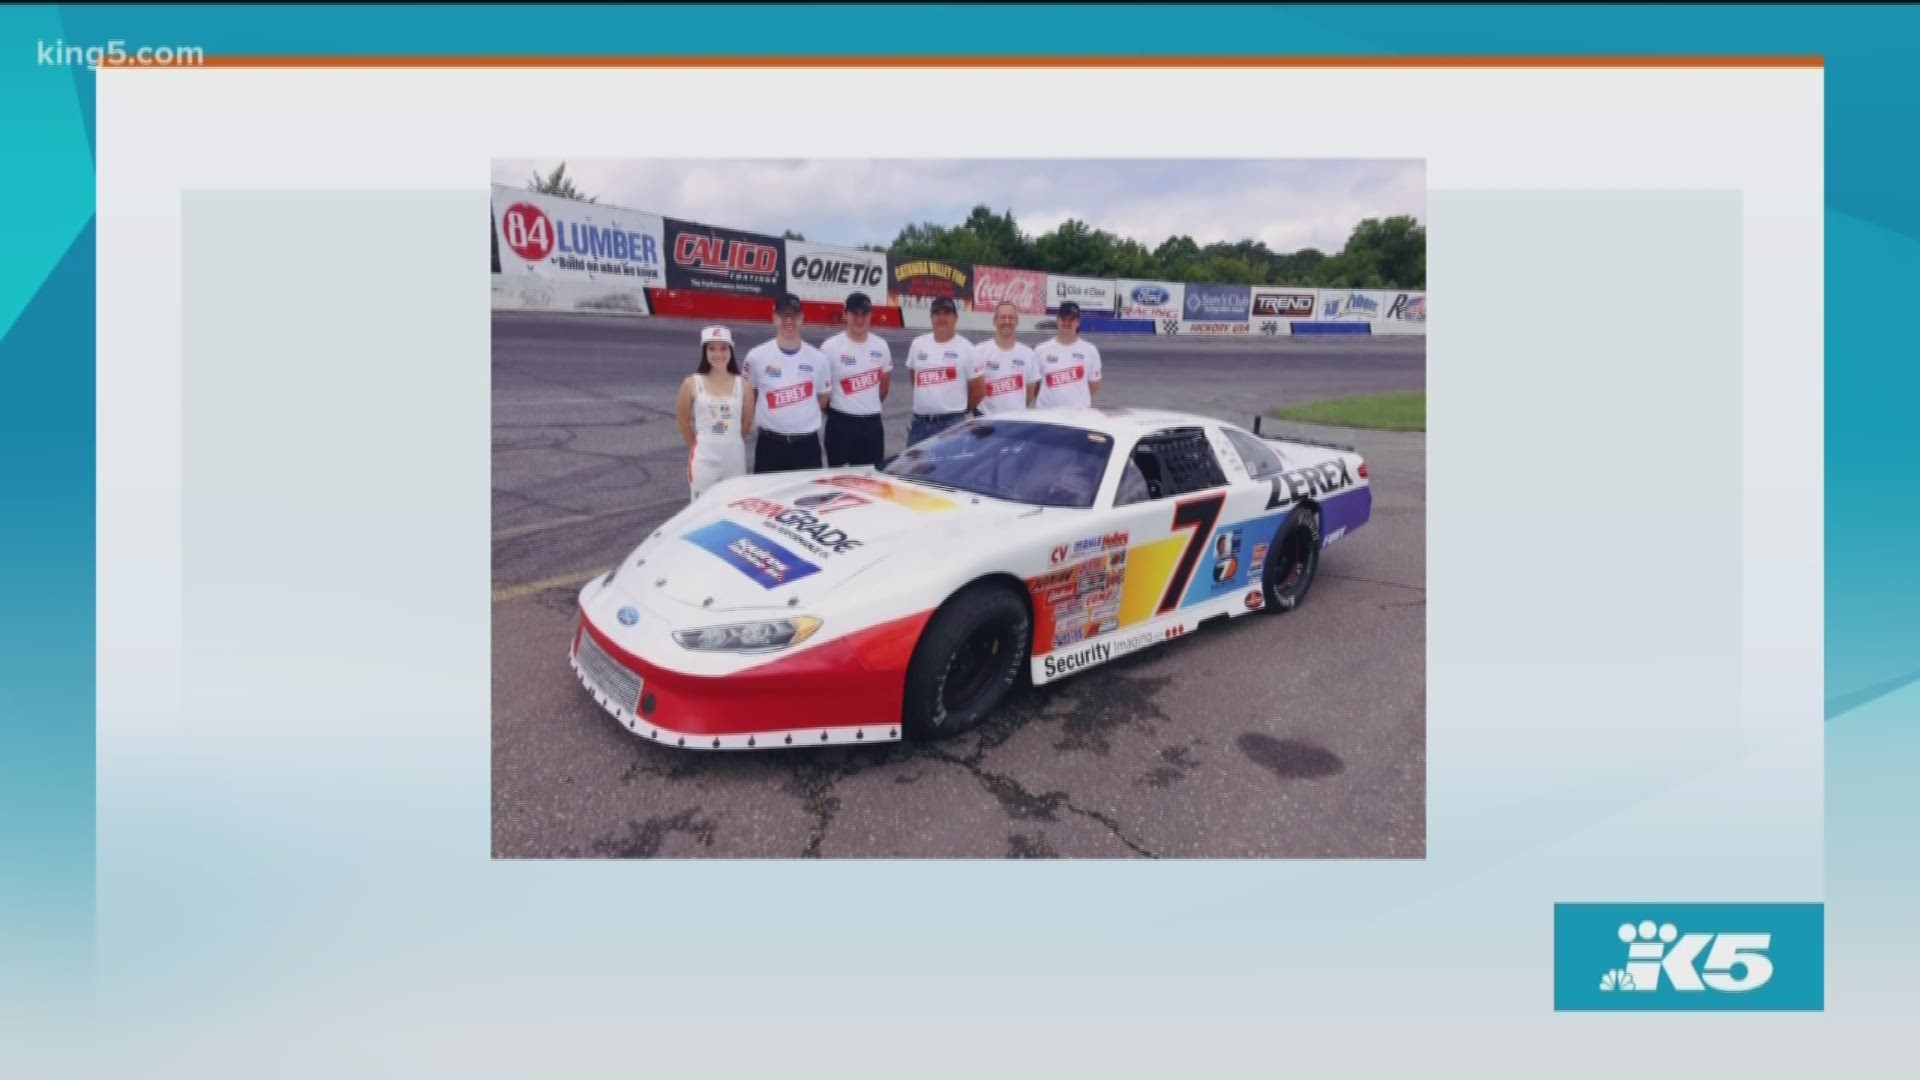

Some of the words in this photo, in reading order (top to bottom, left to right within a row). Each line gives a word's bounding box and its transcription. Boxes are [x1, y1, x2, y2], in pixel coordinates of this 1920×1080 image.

[507, 210, 549, 251] 84
[556, 220, 658, 264] LUMBER
[558, 257, 585, 271] Build
[599, 261, 622, 274] what
[673, 232, 778, 275] CALICO
[791, 254, 883, 287] COMETIC
[1121, 306, 1179, 319] RACING
[1258, 296, 1313, 313] TREND
[1190, 323, 1231, 333] HICKORY
[1232, 323, 1250, 333] USA
[774, 383, 807, 406] ZEREX
[1257, 457, 1354, 511] ZEREX
[1050, 544, 1069, 564] CV
[1156, 490, 1227, 617] 7
[1044, 641, 1111, 678] Security
[1113, 632, 1153, 653] Imaging
